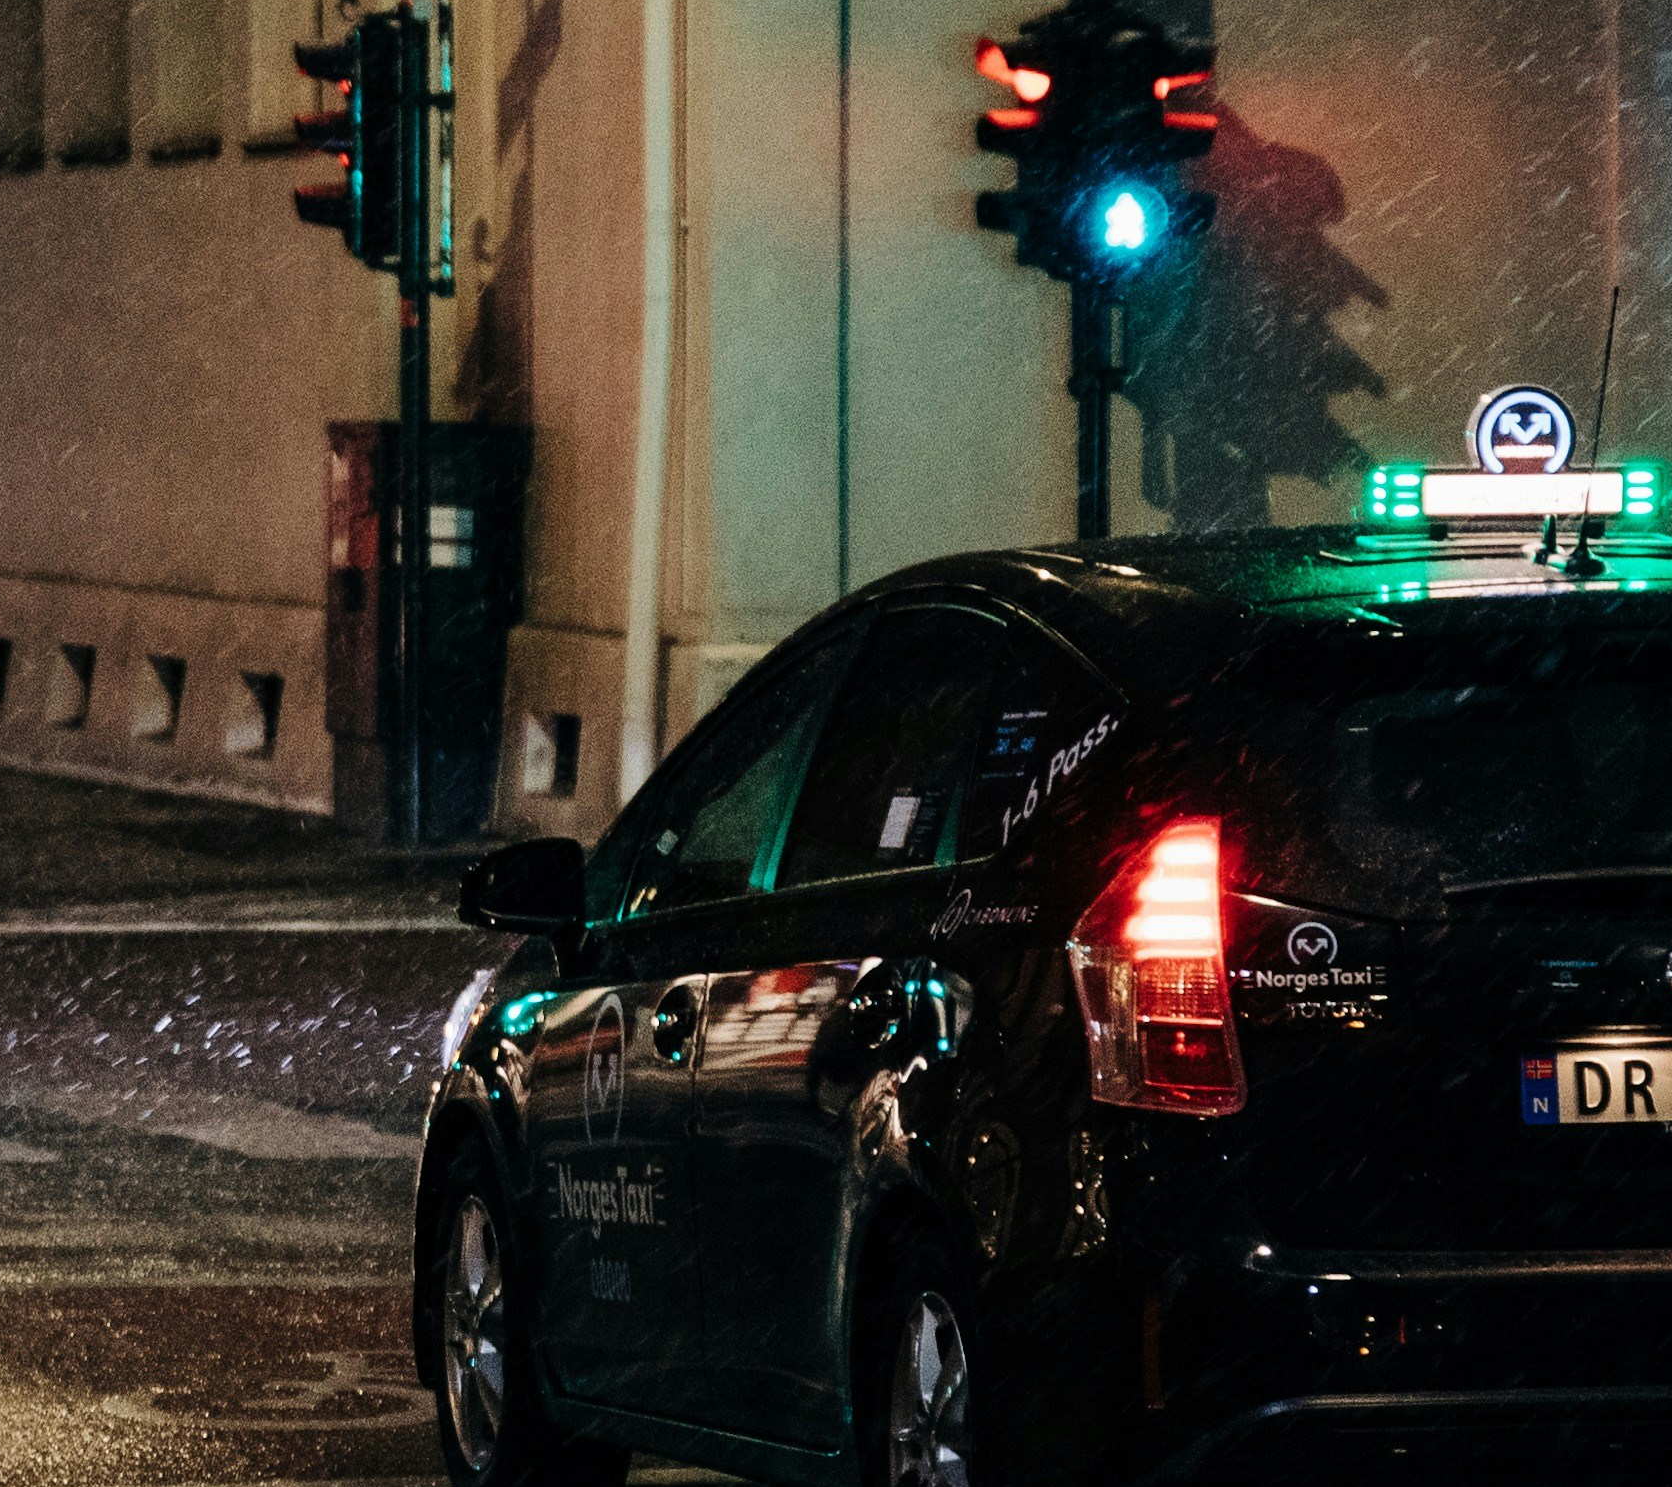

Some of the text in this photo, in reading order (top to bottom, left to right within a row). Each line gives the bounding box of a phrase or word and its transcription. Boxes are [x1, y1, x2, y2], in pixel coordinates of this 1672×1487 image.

[1001, 774, 1040, 848] 1-6
[1045, 713, 1120, 797] Pass.
[1532, 1096, 1550, 1114] N
[1573, 1060, 1657, 1117] DR
